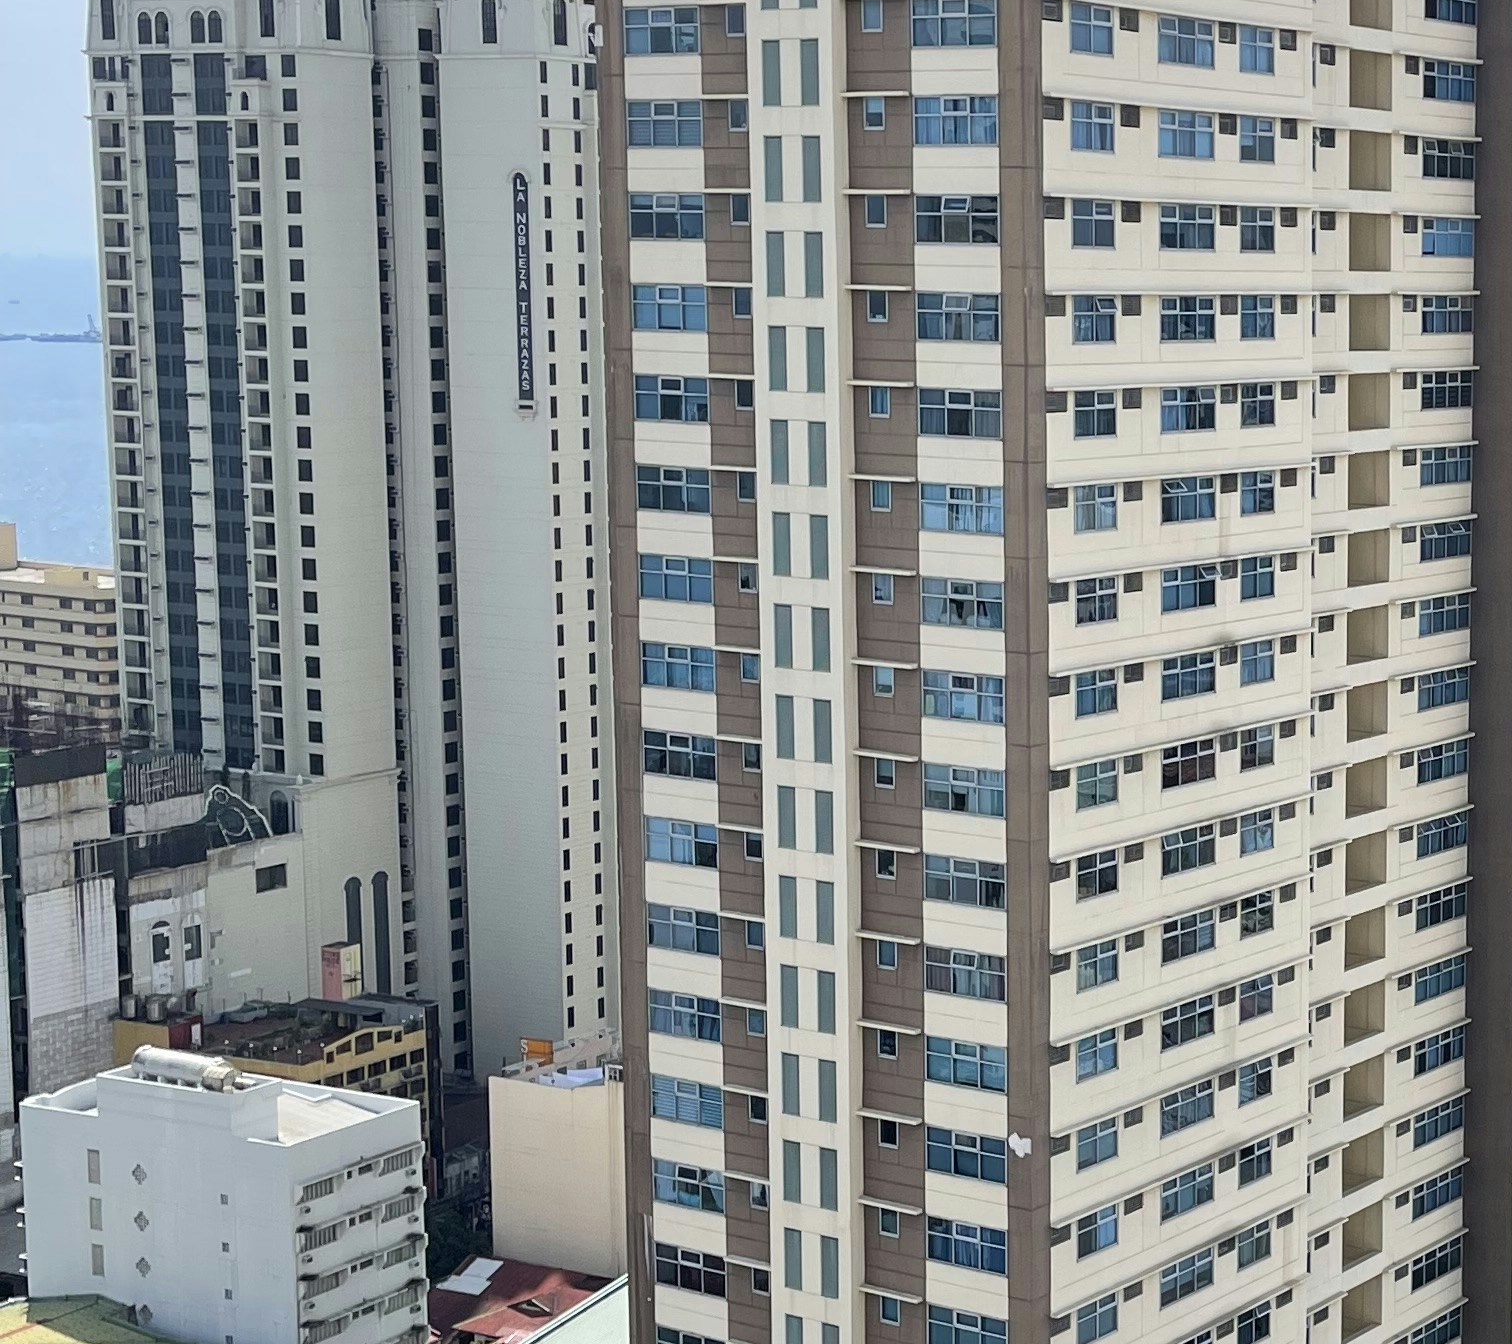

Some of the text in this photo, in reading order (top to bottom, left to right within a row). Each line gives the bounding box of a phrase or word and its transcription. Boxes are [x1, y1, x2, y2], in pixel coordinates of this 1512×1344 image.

[516, 178, 530, 391] LA NOBLEZA TERRAZAS
